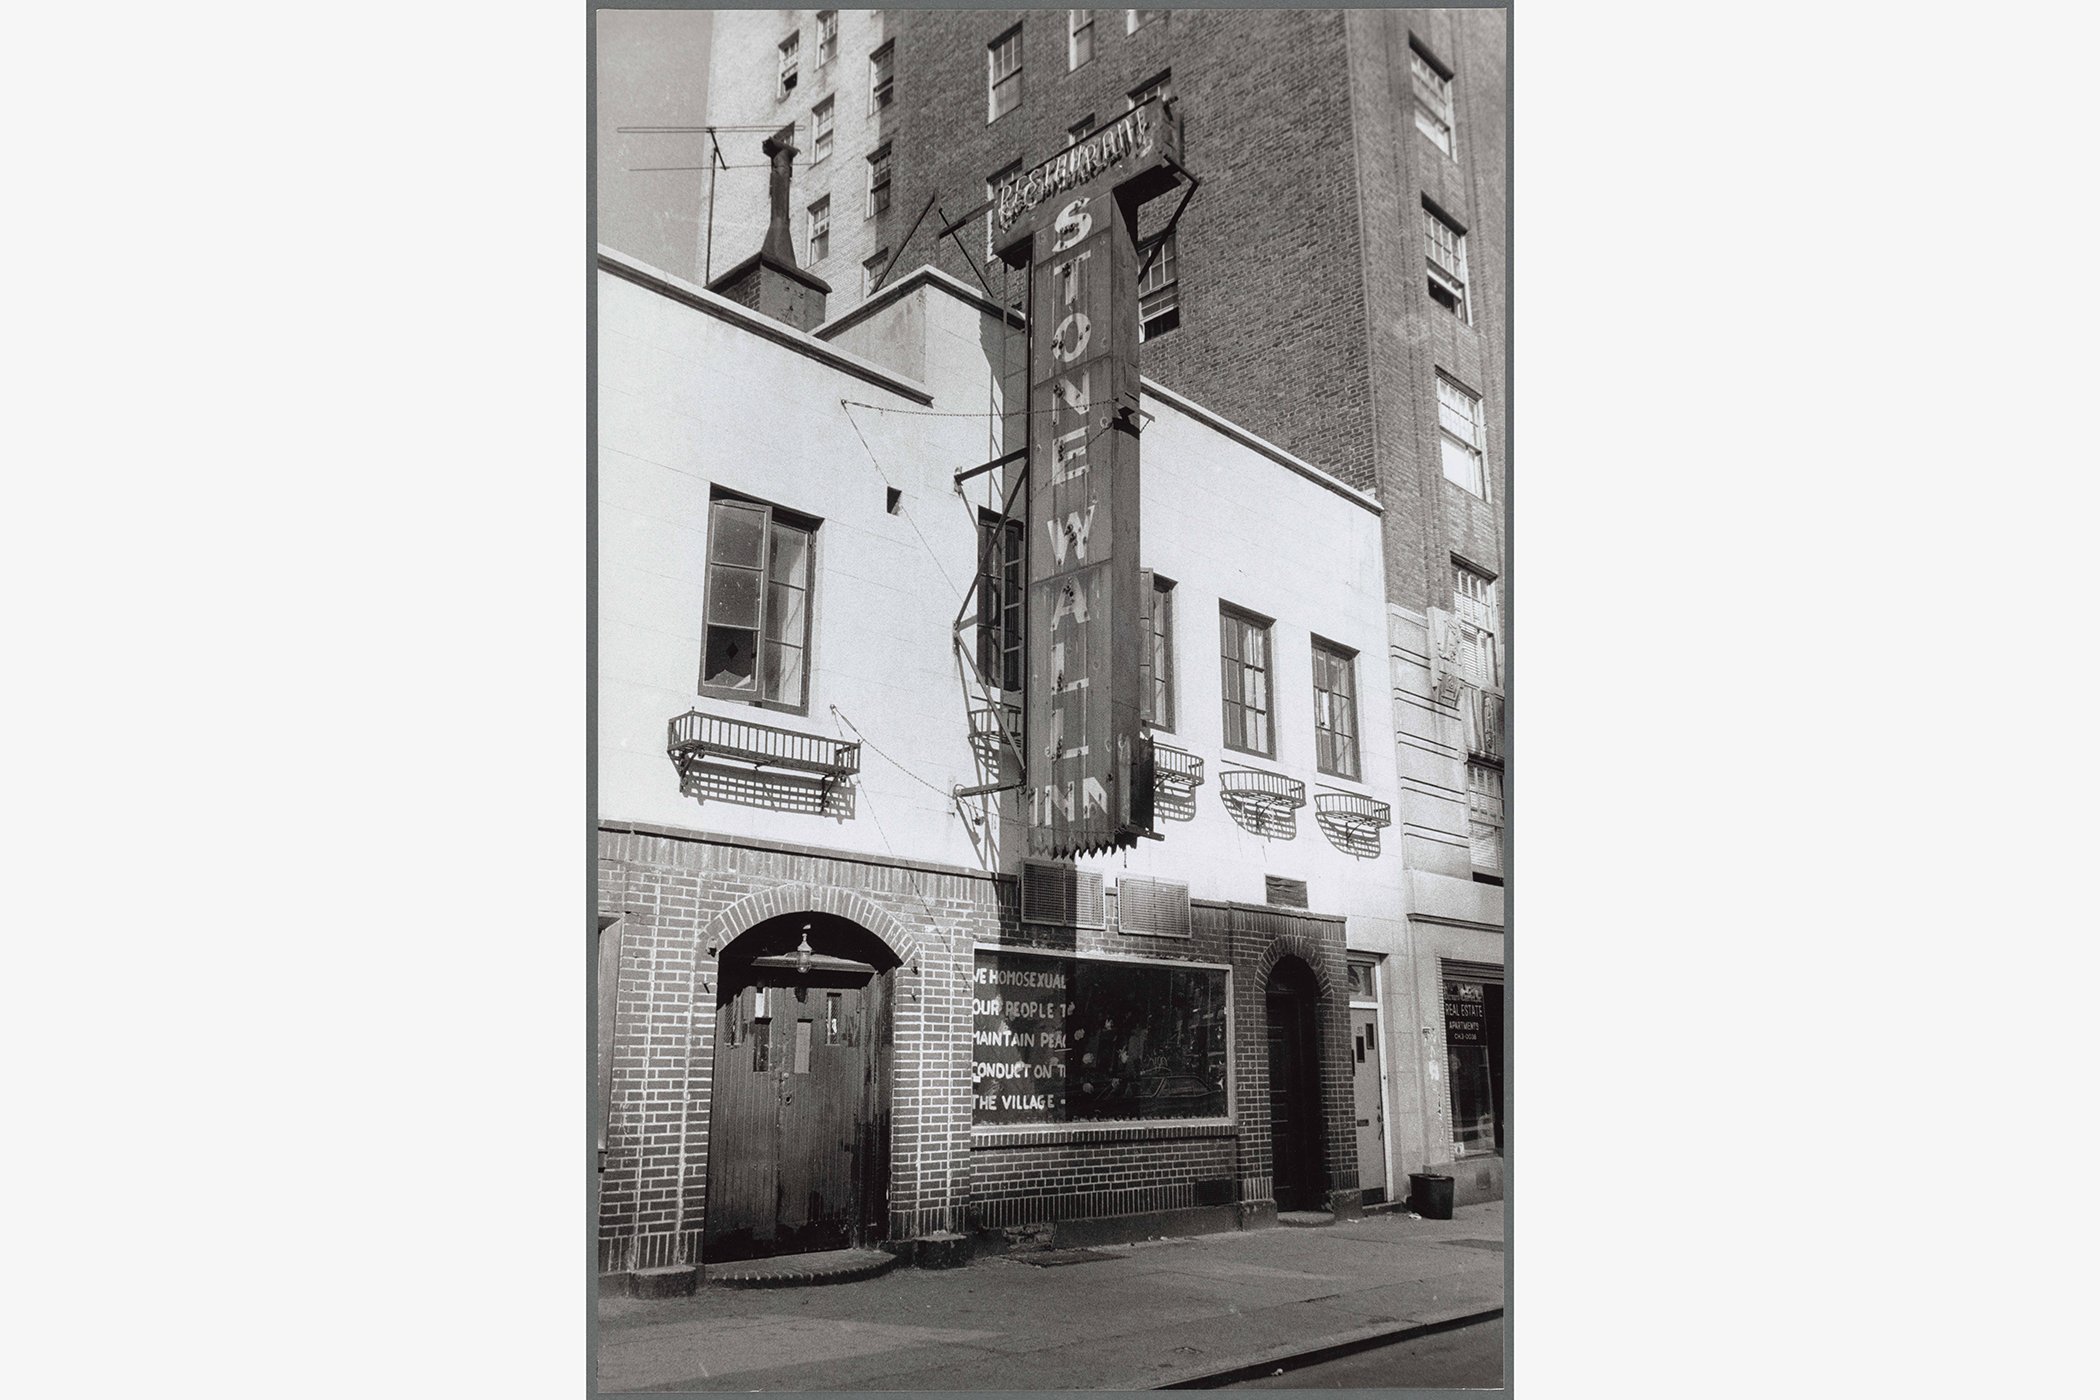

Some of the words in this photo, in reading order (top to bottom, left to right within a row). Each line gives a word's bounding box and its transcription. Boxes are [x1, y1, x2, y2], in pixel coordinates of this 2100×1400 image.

[1048, 197, 1095, 761] STONEWALL
[1030, 777, 1107, 827] INN
[989, 969, 1066, 989] HOMOSEXUAL
[972, 998, 1000, 1016] OUR
[1005, 1001, 1054, 1018] PEOPLE
[1445, 1003, 1460, 1016] REAL
[1461, 1004, 1483, 1018] ESTATE
[1449, 1020, 1479, 1031] APARTMENTS
[973, 1030, 1035, 1047] MAINTAIN
[972, 1061, 1031, 1079] CONDUCT
[1033, 1064, 1052, 1079] ON
[972, 1095, 997, 1110] THE
[1001, 1094, 1055, 1110] VILLAGE
